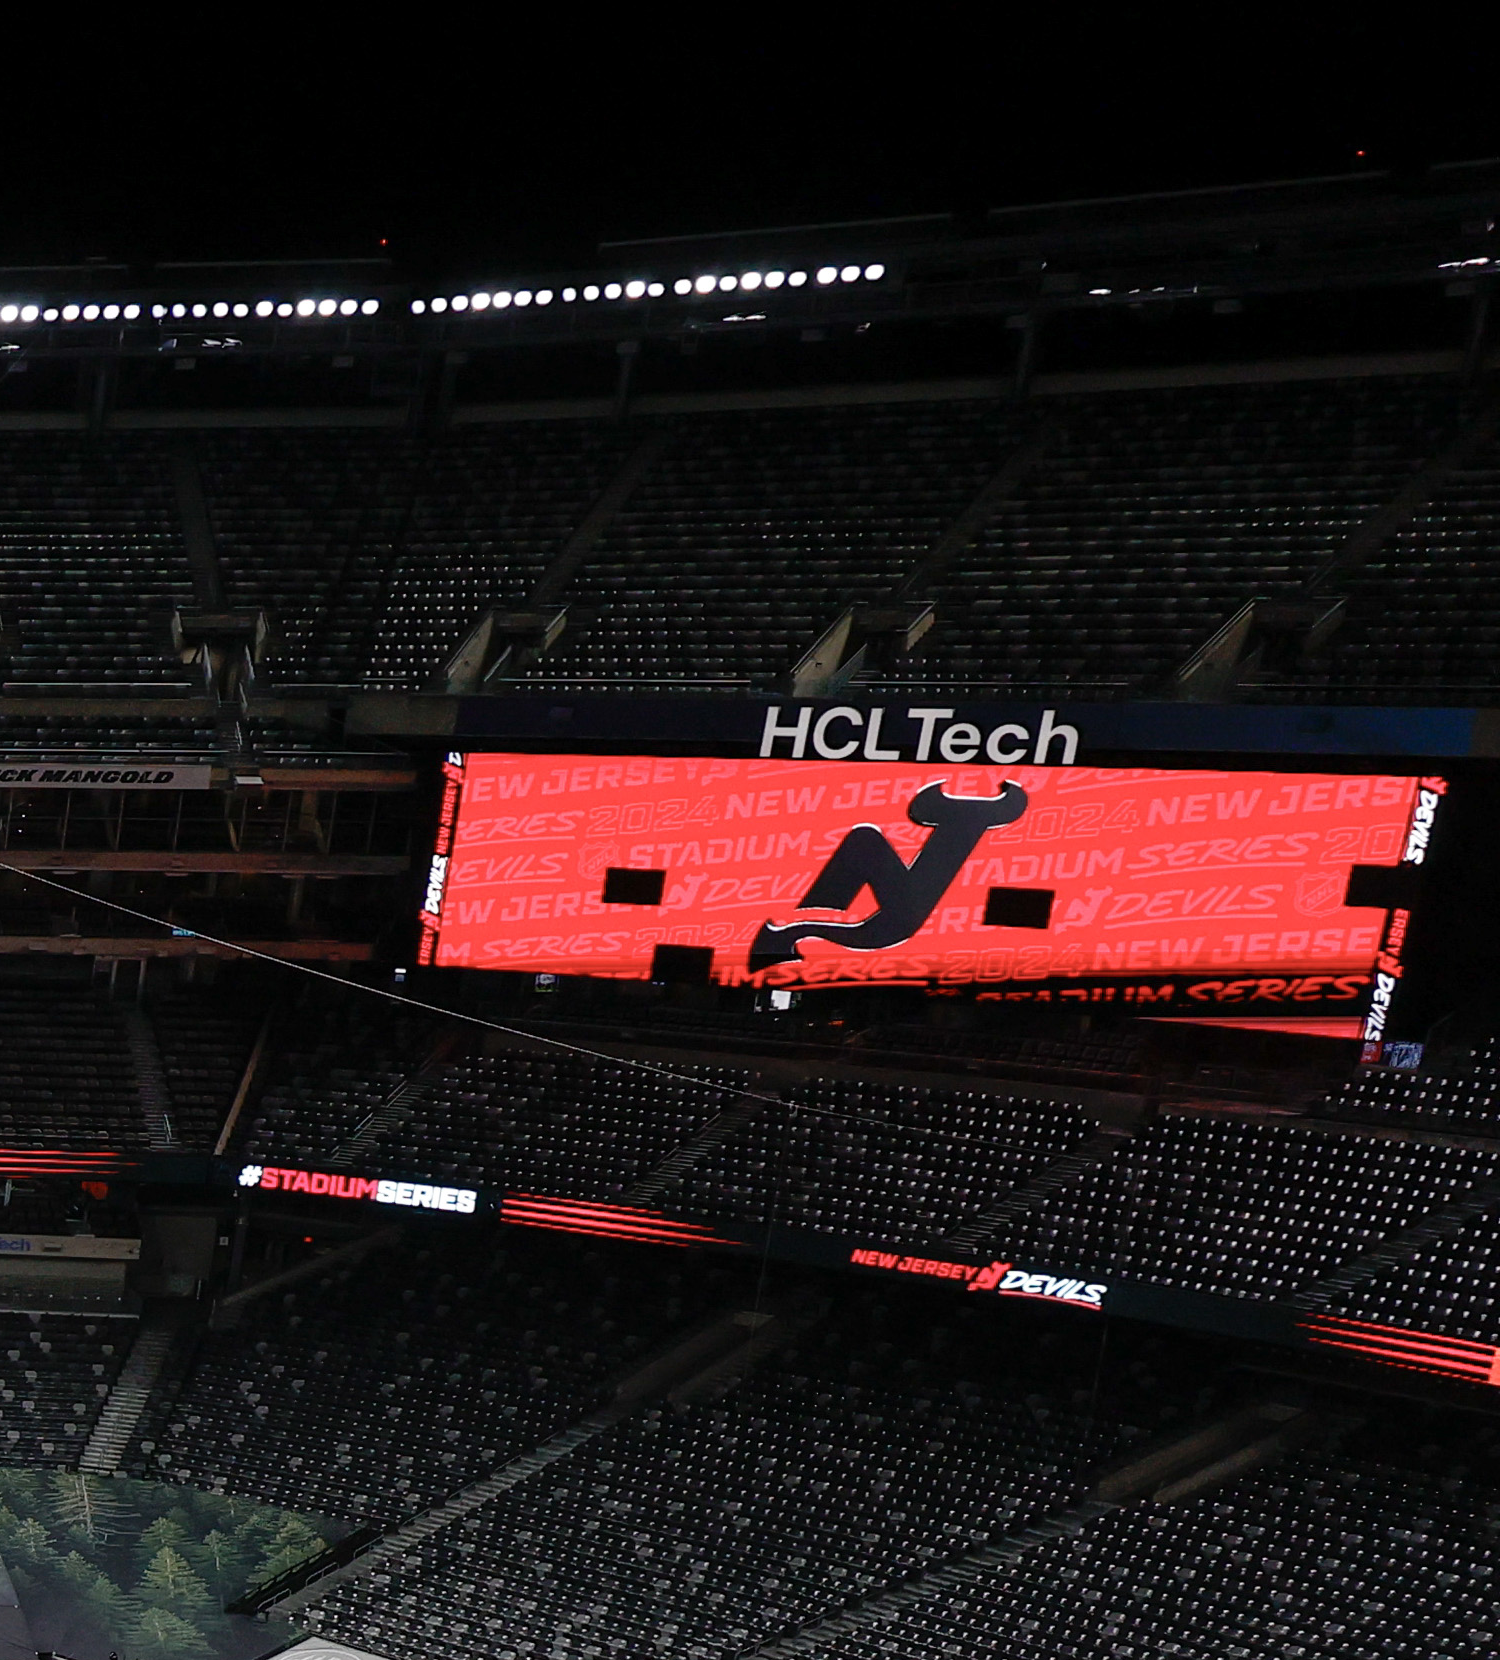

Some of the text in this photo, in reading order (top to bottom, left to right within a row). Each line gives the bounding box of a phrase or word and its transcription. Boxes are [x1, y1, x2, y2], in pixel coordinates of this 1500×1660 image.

[759, 706, 1080, 765] HCLTech
[35, 769, 175, 784] MANGOLD
[238, 1164, 476, 1215] #STADIUMSERIES
[850, 1248, 1108, 1304] NEW JERSEY DEVILS
